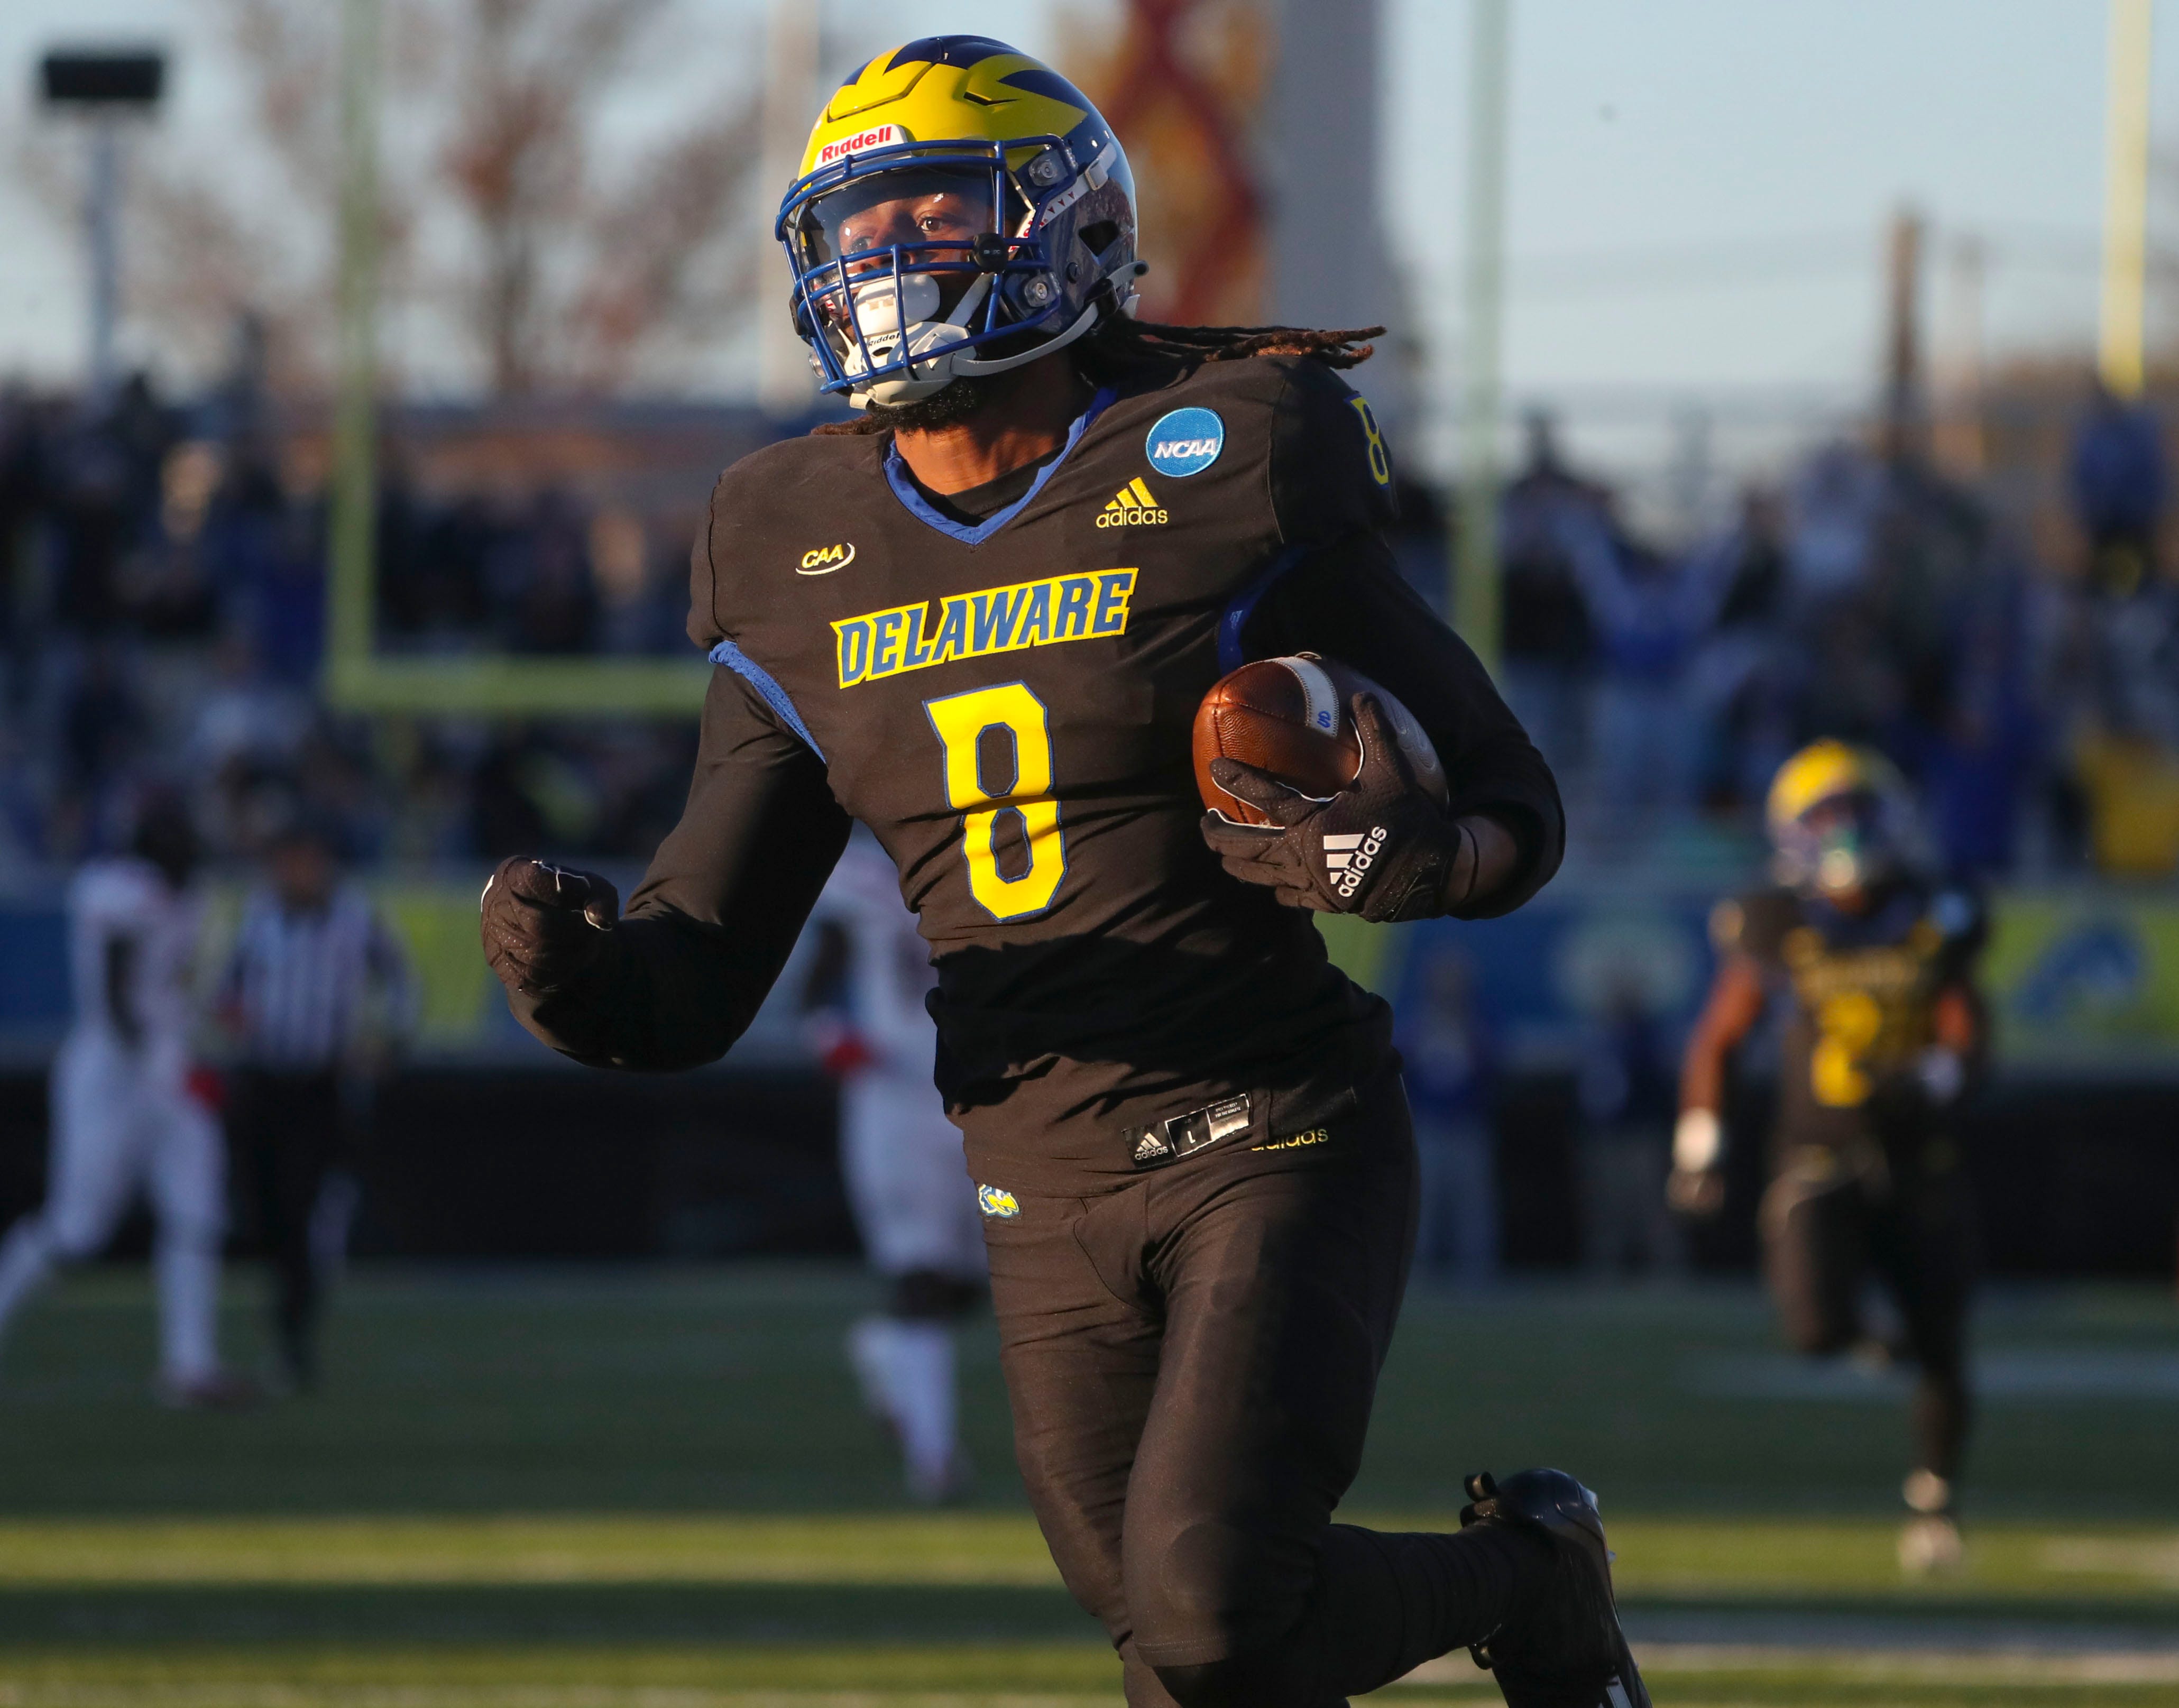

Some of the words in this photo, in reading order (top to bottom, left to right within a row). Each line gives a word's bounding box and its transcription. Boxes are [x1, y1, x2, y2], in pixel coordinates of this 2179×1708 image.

[822, 126, 892, 162] Riddell
[868, 332, 900, 348] Riddel
[1154, 437, 1218, 458] NCAA
[1346, 393, 1391, 488] 8
[1096, 506, 1168, 528] adidas
[802, 544, 844, 568] CAA
[830, 568, 1139, 689] DELAWARE
[922, 679, 1069, 923] 8
[1338, 826, 1387, 897] adidas
[1187, 1131, 1196, 1144] L
[1135, 1146, 1169, 1160] adidas
